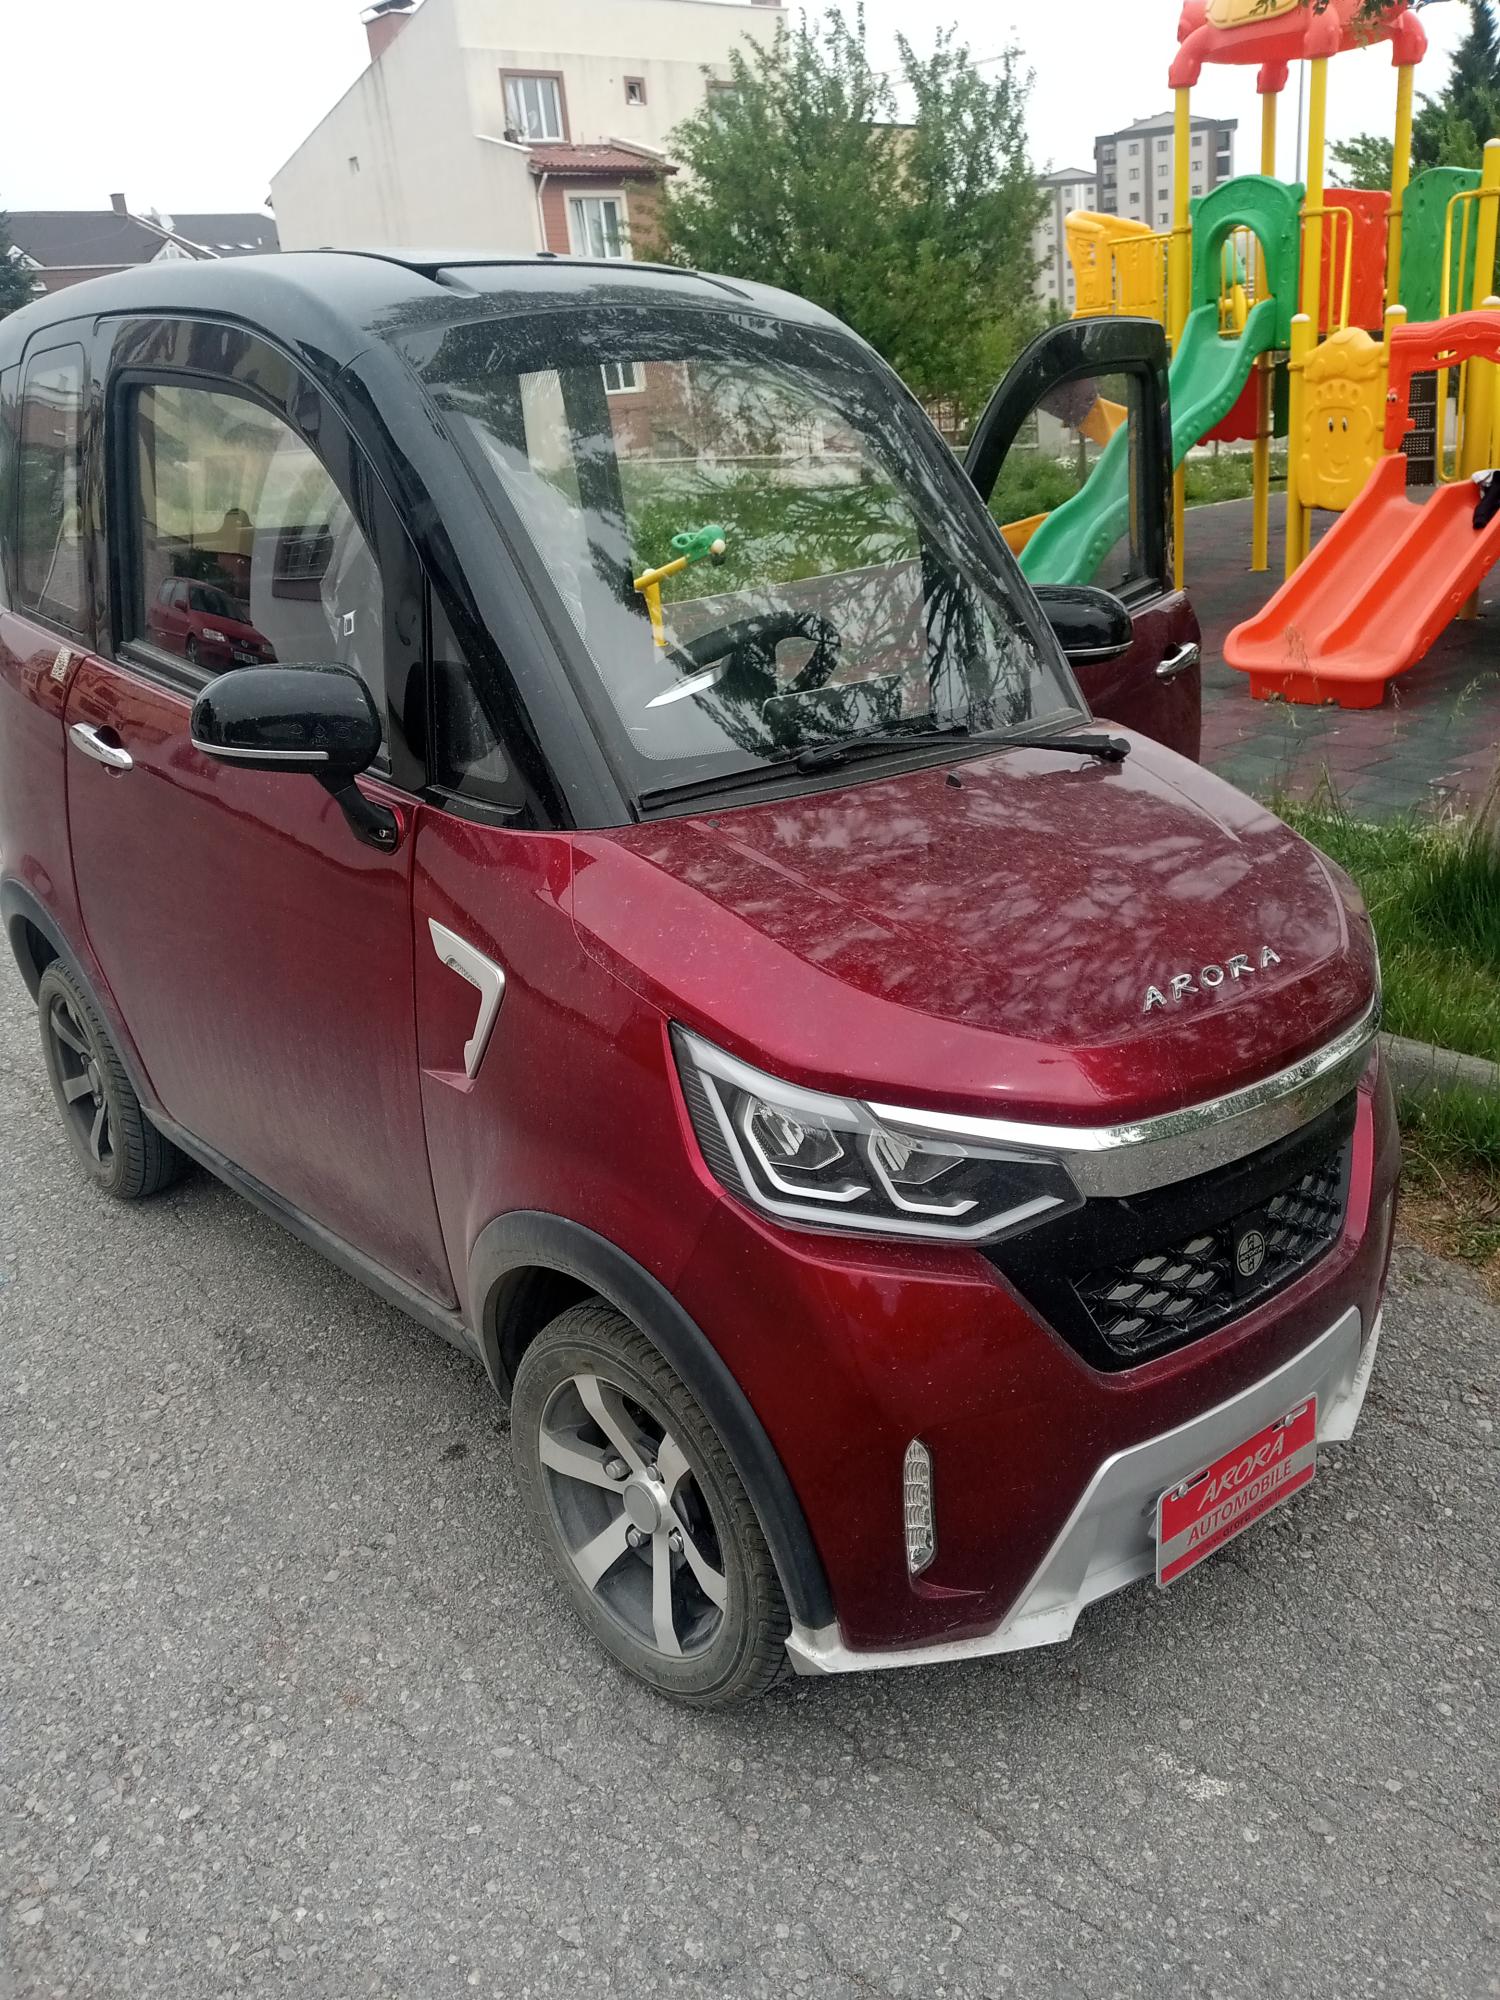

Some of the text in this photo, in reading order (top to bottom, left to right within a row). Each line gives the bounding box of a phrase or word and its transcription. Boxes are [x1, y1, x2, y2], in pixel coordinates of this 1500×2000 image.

[1143, 945, 1281, 1013] ARORA
[1187, 1458, 1293, 1546] AUTOMOBILE
[1197, 1432, 1285, 1512] ARORA
